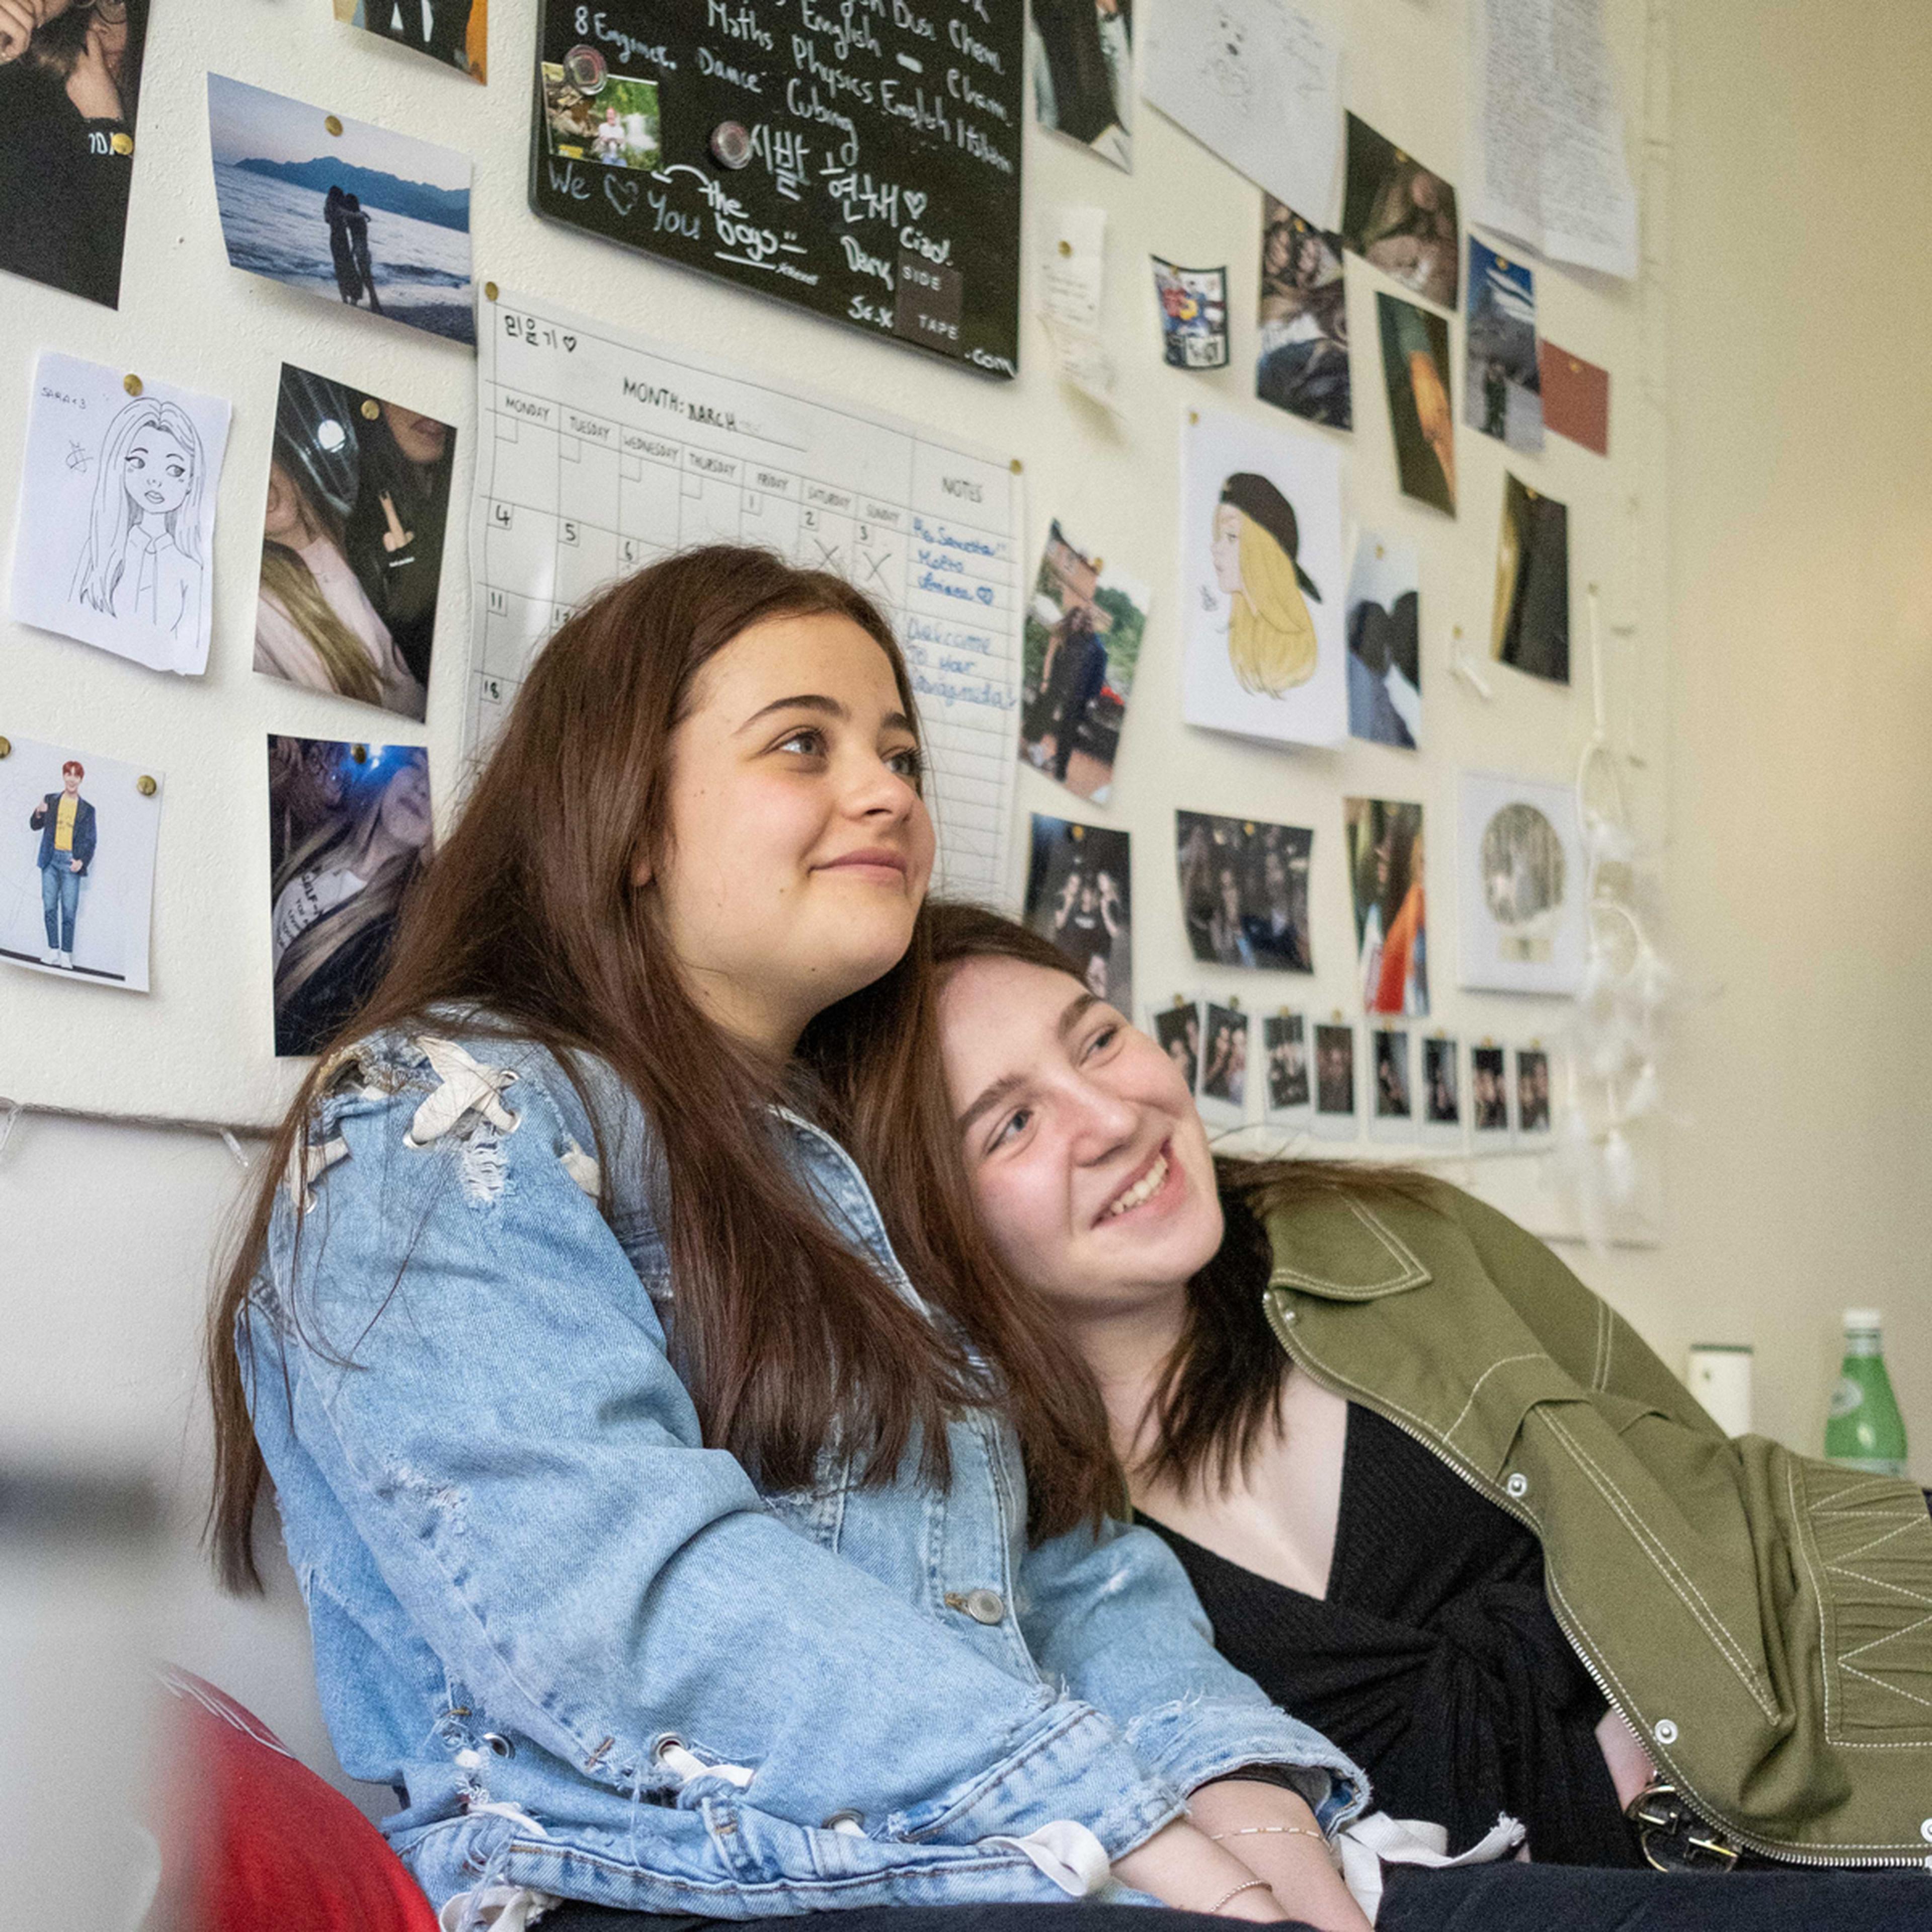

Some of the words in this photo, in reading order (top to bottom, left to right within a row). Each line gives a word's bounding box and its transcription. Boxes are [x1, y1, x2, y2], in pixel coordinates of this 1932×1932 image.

[575, 6, 589, 35] 8
[707, 1, 773, 50] Maths
[801, 0, 882, 60] English
[697, 47, 762, 93] Dance
[791, 34, 874, 103] Physics
[549, 160, 591, 199] We
[698, 180, 749, 218] the
[714, 212, 779, 261] boys
[902, 265, 942, 291] SIDE
[918, 314, 959, 340] TAPE
[623, 377, 684, 413] MONTH:
[505, 396, 551, 421] MONDAY
[570, 416, 610, 441] TUESDAY
[623, 435, 679, 462] WEDNESDAY
[689, 453, 737, 478] THURSDAY
[757, 472, 789, 491] FRIDAY
[808, 486, 852, 510] SATURDAY
[866, 504, 901, 524] SUNDAY
[942, 477, 983, 504] NOTES
[496, 504, 510, 526] 4
[565, 523, 576, 541] 5
[625, 541, 633, 561] 6
[805, 511, 815, 526] 2
[860, 525, 868, 540] 3
[491, 592, 502, 609] 11
[484, 680, 500, 699] 18
